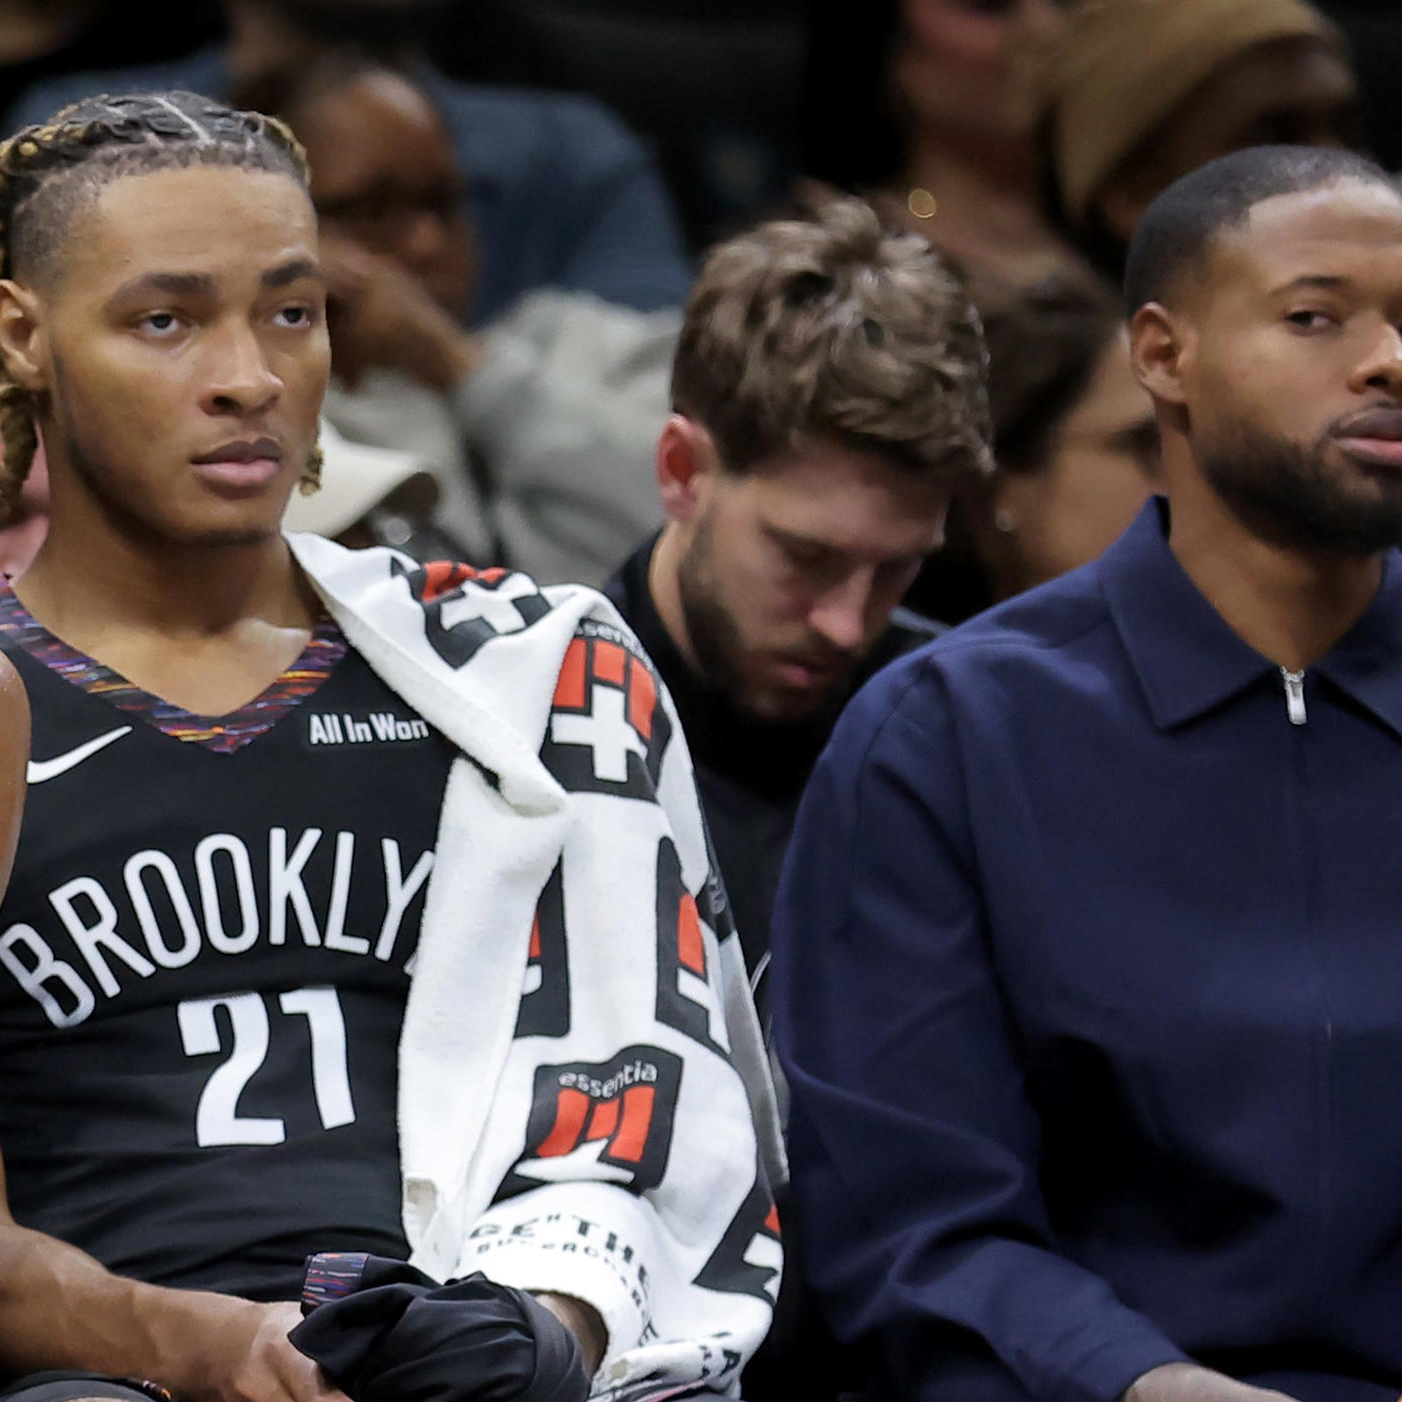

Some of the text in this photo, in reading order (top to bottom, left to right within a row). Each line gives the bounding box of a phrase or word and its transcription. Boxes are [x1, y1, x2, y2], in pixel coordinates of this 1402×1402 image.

[310, 713, 429, 744] All In Won
[176, 984, 356, 1148] 21
[558, 1059, 658, 1098] essentia
